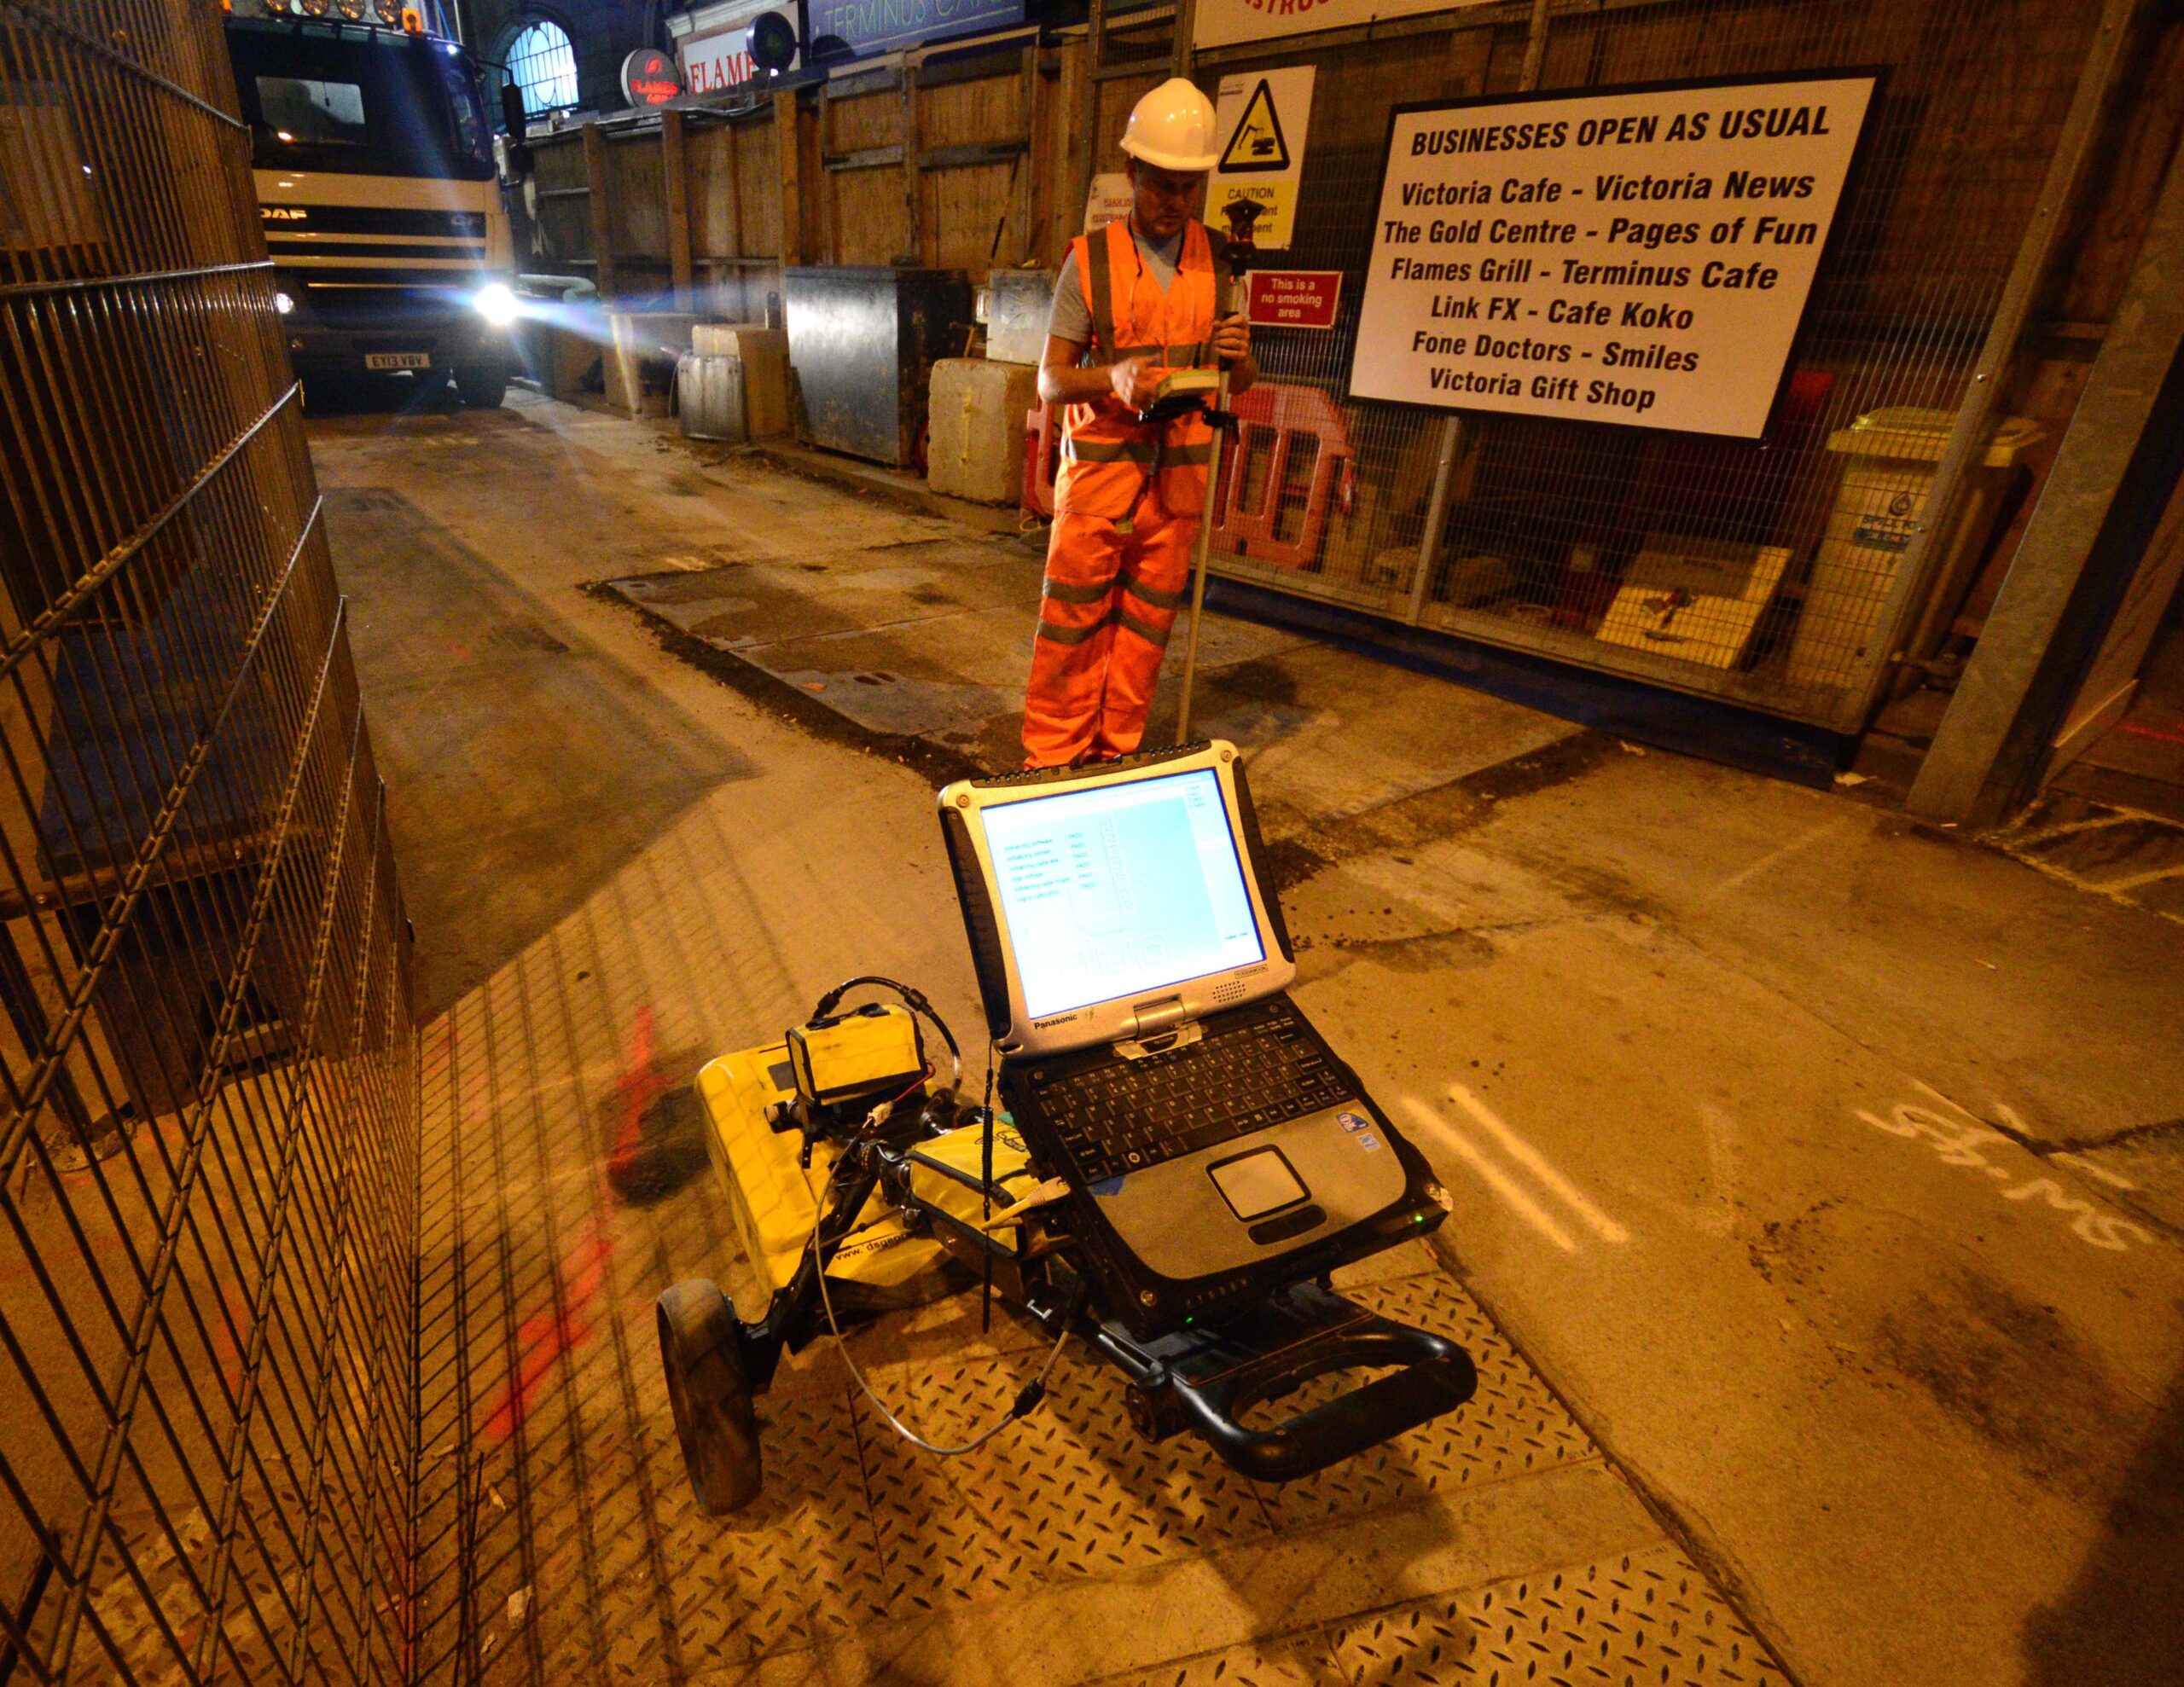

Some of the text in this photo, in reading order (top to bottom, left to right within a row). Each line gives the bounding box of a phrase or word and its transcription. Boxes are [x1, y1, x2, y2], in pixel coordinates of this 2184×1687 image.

[1411, 106, 1829, 156] BUSINESSES OPEN AS USUAL
[1228, 186, 1274, 199] CAUTION
[1403, 180, 1491, 206] Victoria
[1501, 177, 1562, 204] Cafe
[1596, 172, 1712, 201] Victoria
[1722, 171, 1815, 199] News
[1385, 221, 1421, 243] The
[1429, 219, 1482, 244] Gold
[1490, 219, 1577, 244] Centre
[1607, 217, 1700, 249] Pages
[1710, 217, 1746, 244] of
[1753, 217, 1817, 245] Fun
[1271, 278, 1315, 290] This is a
[1391, 258, 1472, 281] Flames
[1479, 258, 1532, 282] Grill
[1563, 259, 1691, 287] Terminus
[1701, 261, 1779, 290] Cafe
[1261, 293, 1322, 308] no smoking
[1278, 308, 1301, 318] area
[1432, 295, 1480, 319] Link
[1488, 298, 1521, 321] FX
[1548, 299, 1611, 325] Cafe
[1621, 302, 1693, 329] Koko
[1413, 331, 1467, 355] Fone
[1474, 334, 1571, 362] Doctors
[1602, 342, 1699, 372] Smiles
[1432, 368, 1655, 413] Victoria Gift Shop
[1034, 1013, 1077, 1030] Panasonic
